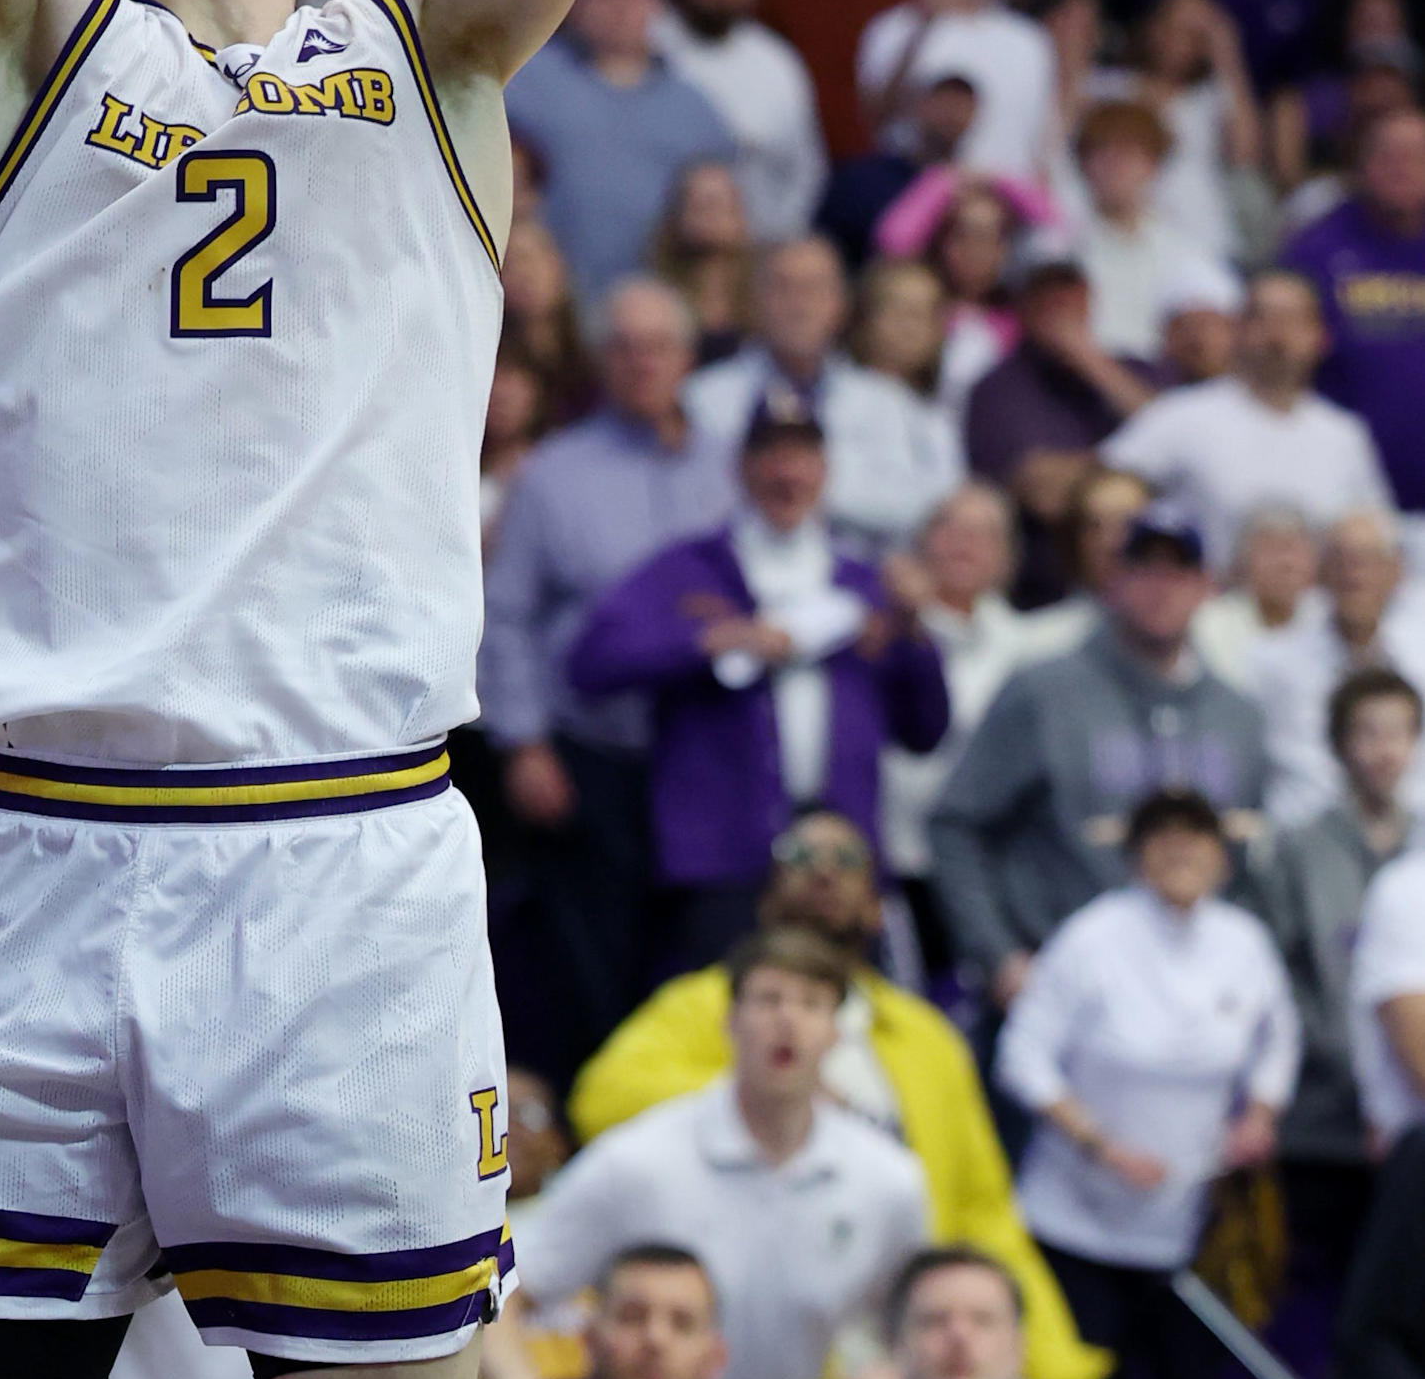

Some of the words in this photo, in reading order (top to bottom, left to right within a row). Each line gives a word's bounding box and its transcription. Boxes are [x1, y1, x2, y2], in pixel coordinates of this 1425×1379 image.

[85, 67, 395, 169] LIPOMB
[171, 150, 276, 338] 2
[469, 1086, 508, 1181] L
